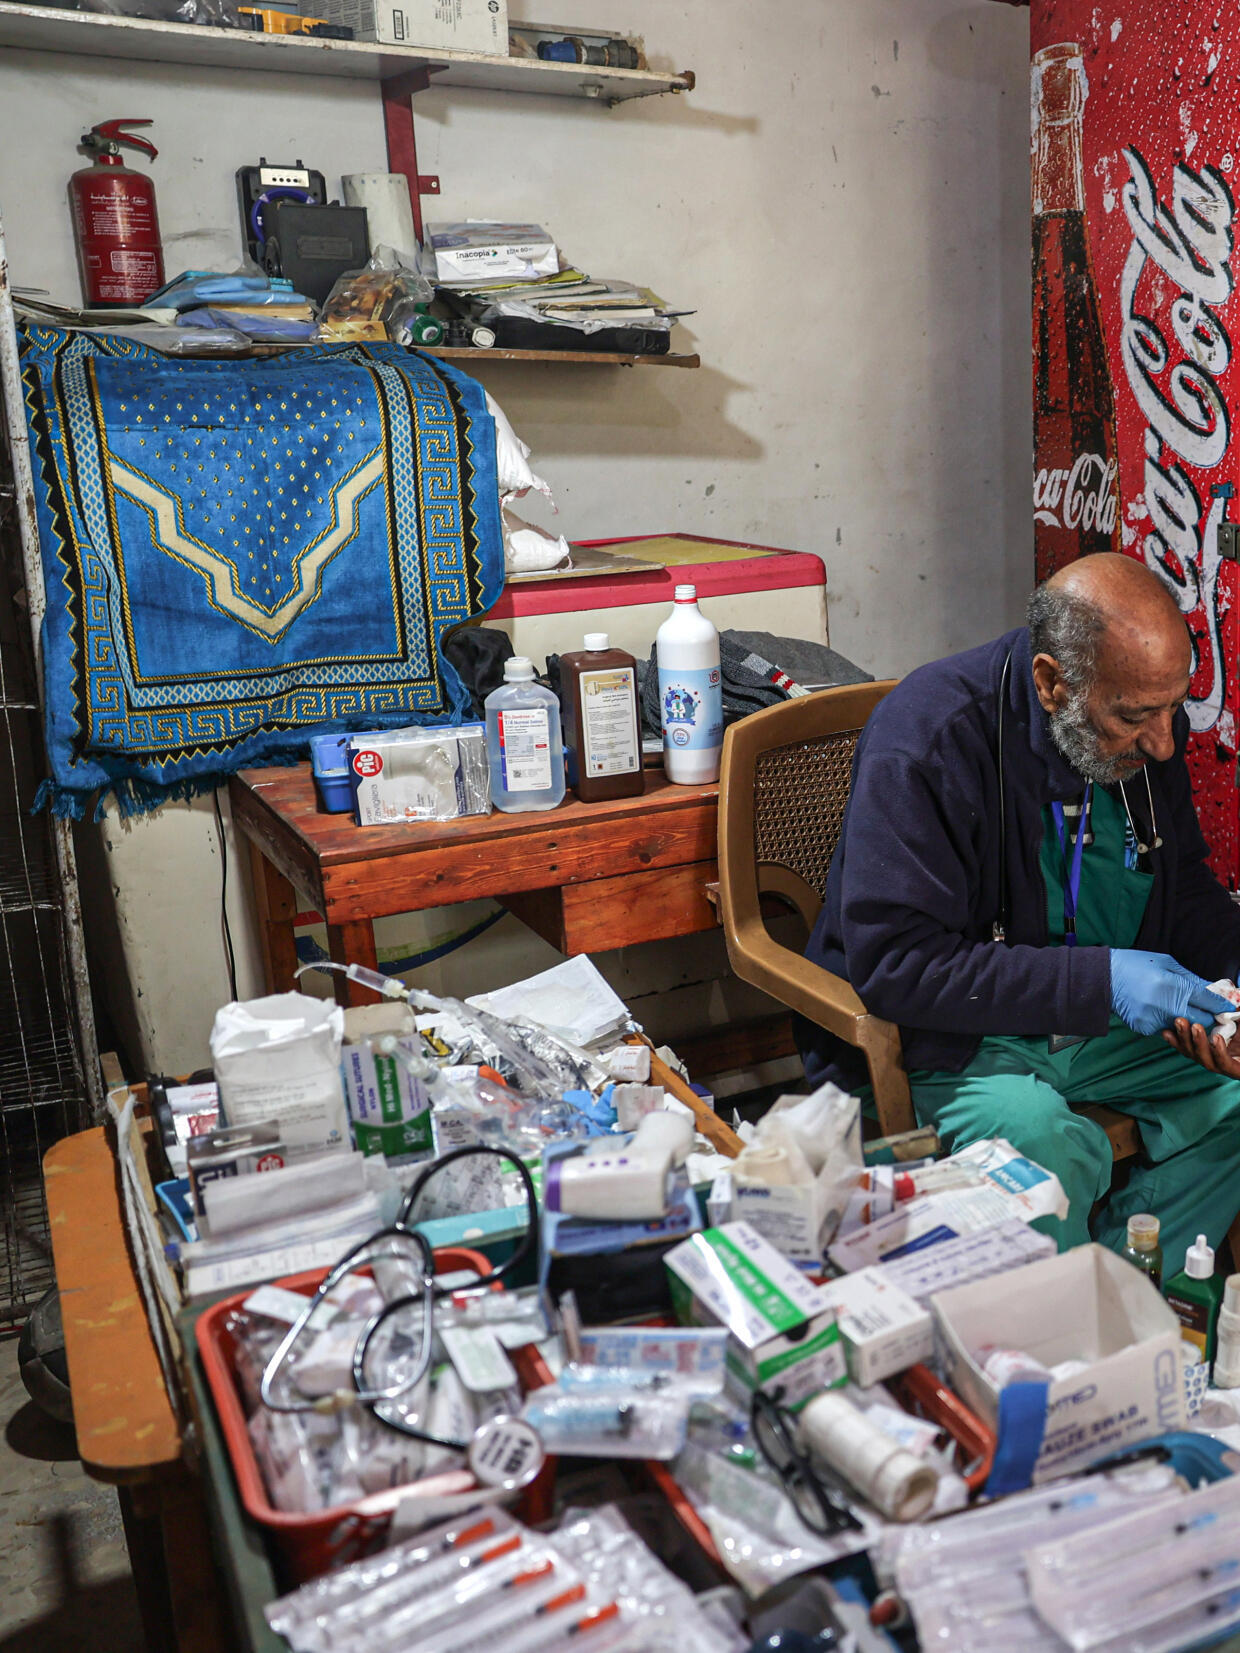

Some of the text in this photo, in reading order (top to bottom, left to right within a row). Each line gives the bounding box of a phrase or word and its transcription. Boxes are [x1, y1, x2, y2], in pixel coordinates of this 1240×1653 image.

[456, 249, 490, 260] Inacopia
[351, 1052, 368, 1119] SURGICAL SUTURES
[368, 1087, 376, 1111] NYLON
